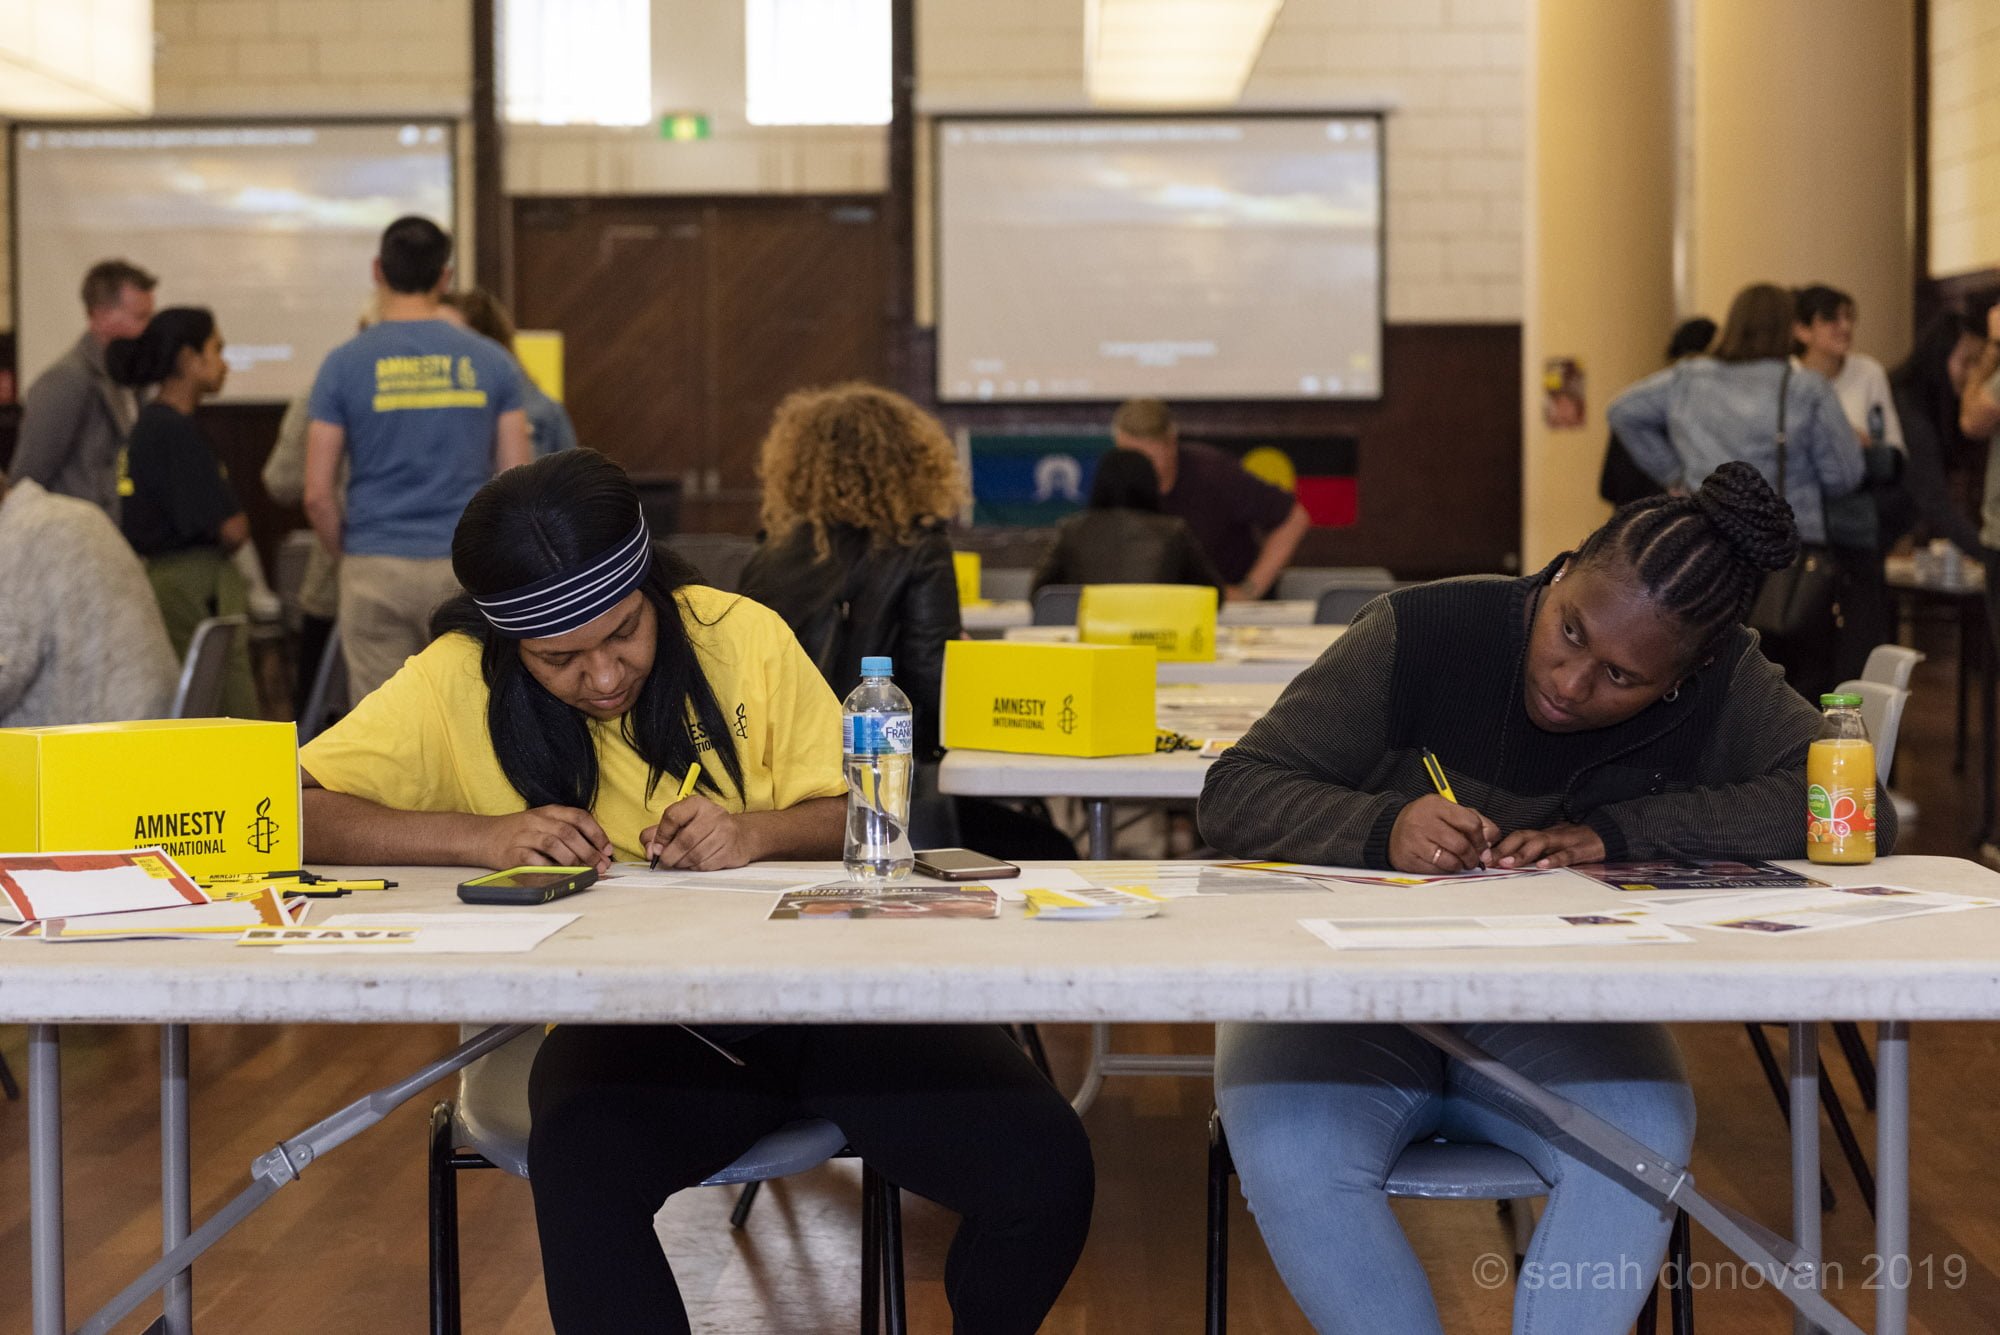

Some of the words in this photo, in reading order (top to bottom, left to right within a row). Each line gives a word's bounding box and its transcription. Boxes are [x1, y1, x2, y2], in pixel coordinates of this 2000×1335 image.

[993, 697, 1046, 716] AMNESTY
[993, 717, 1045, 730] INTERNATIONAL
[134, 810, 226, 840] AMNESTY
[135, 839, 226, 857] RNATIONAL
